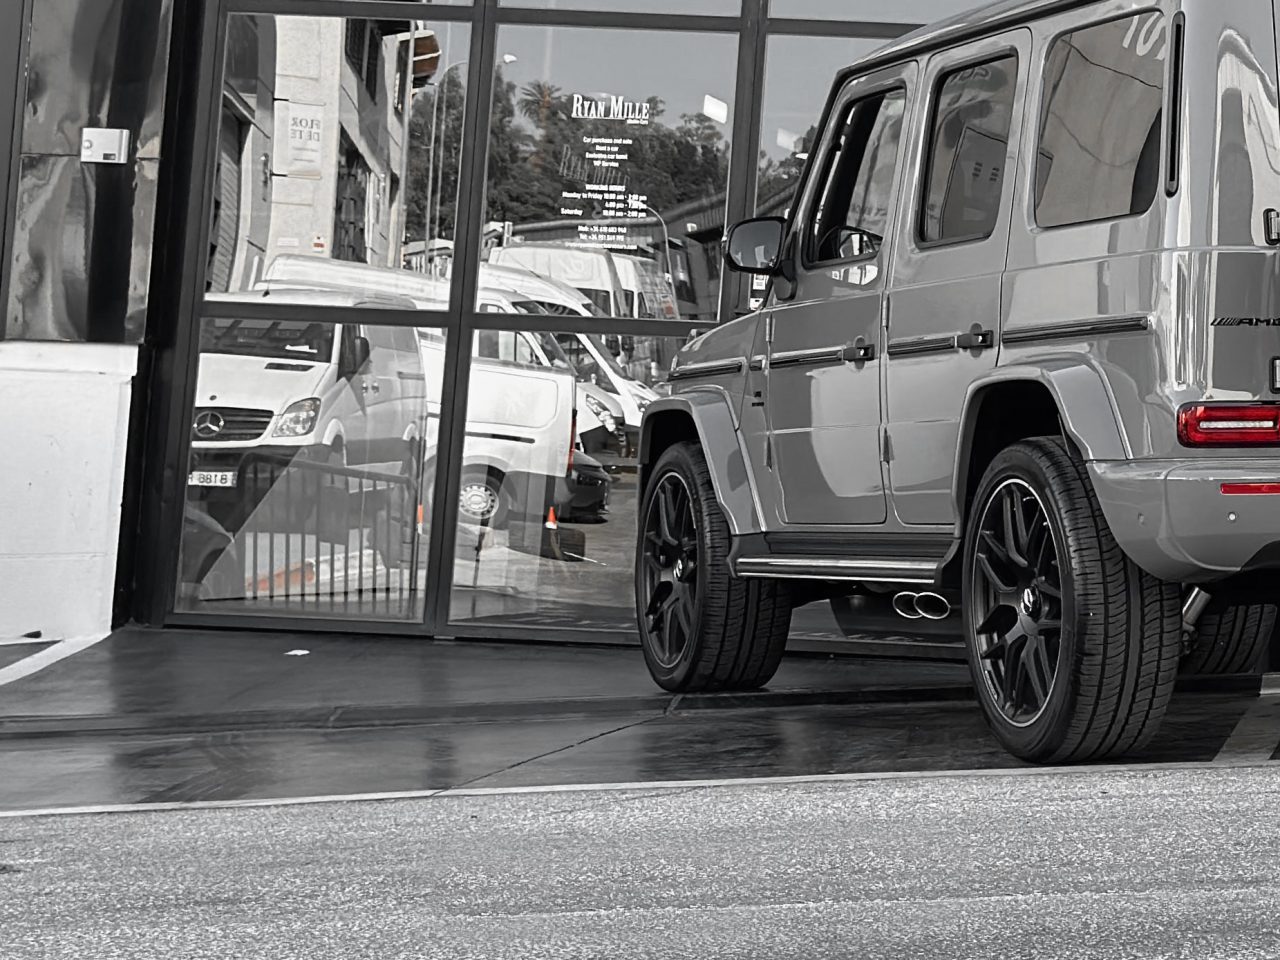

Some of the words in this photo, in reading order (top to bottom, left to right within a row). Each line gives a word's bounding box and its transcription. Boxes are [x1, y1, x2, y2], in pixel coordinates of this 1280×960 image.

[571, 93, 605, 119] RYAN
[610, 95, 650, 120] MILLE
[562, 191, 581, 199] Monday
[587, 192, 603, 200] Friday
[561, 207, 583, 216] Saturday
